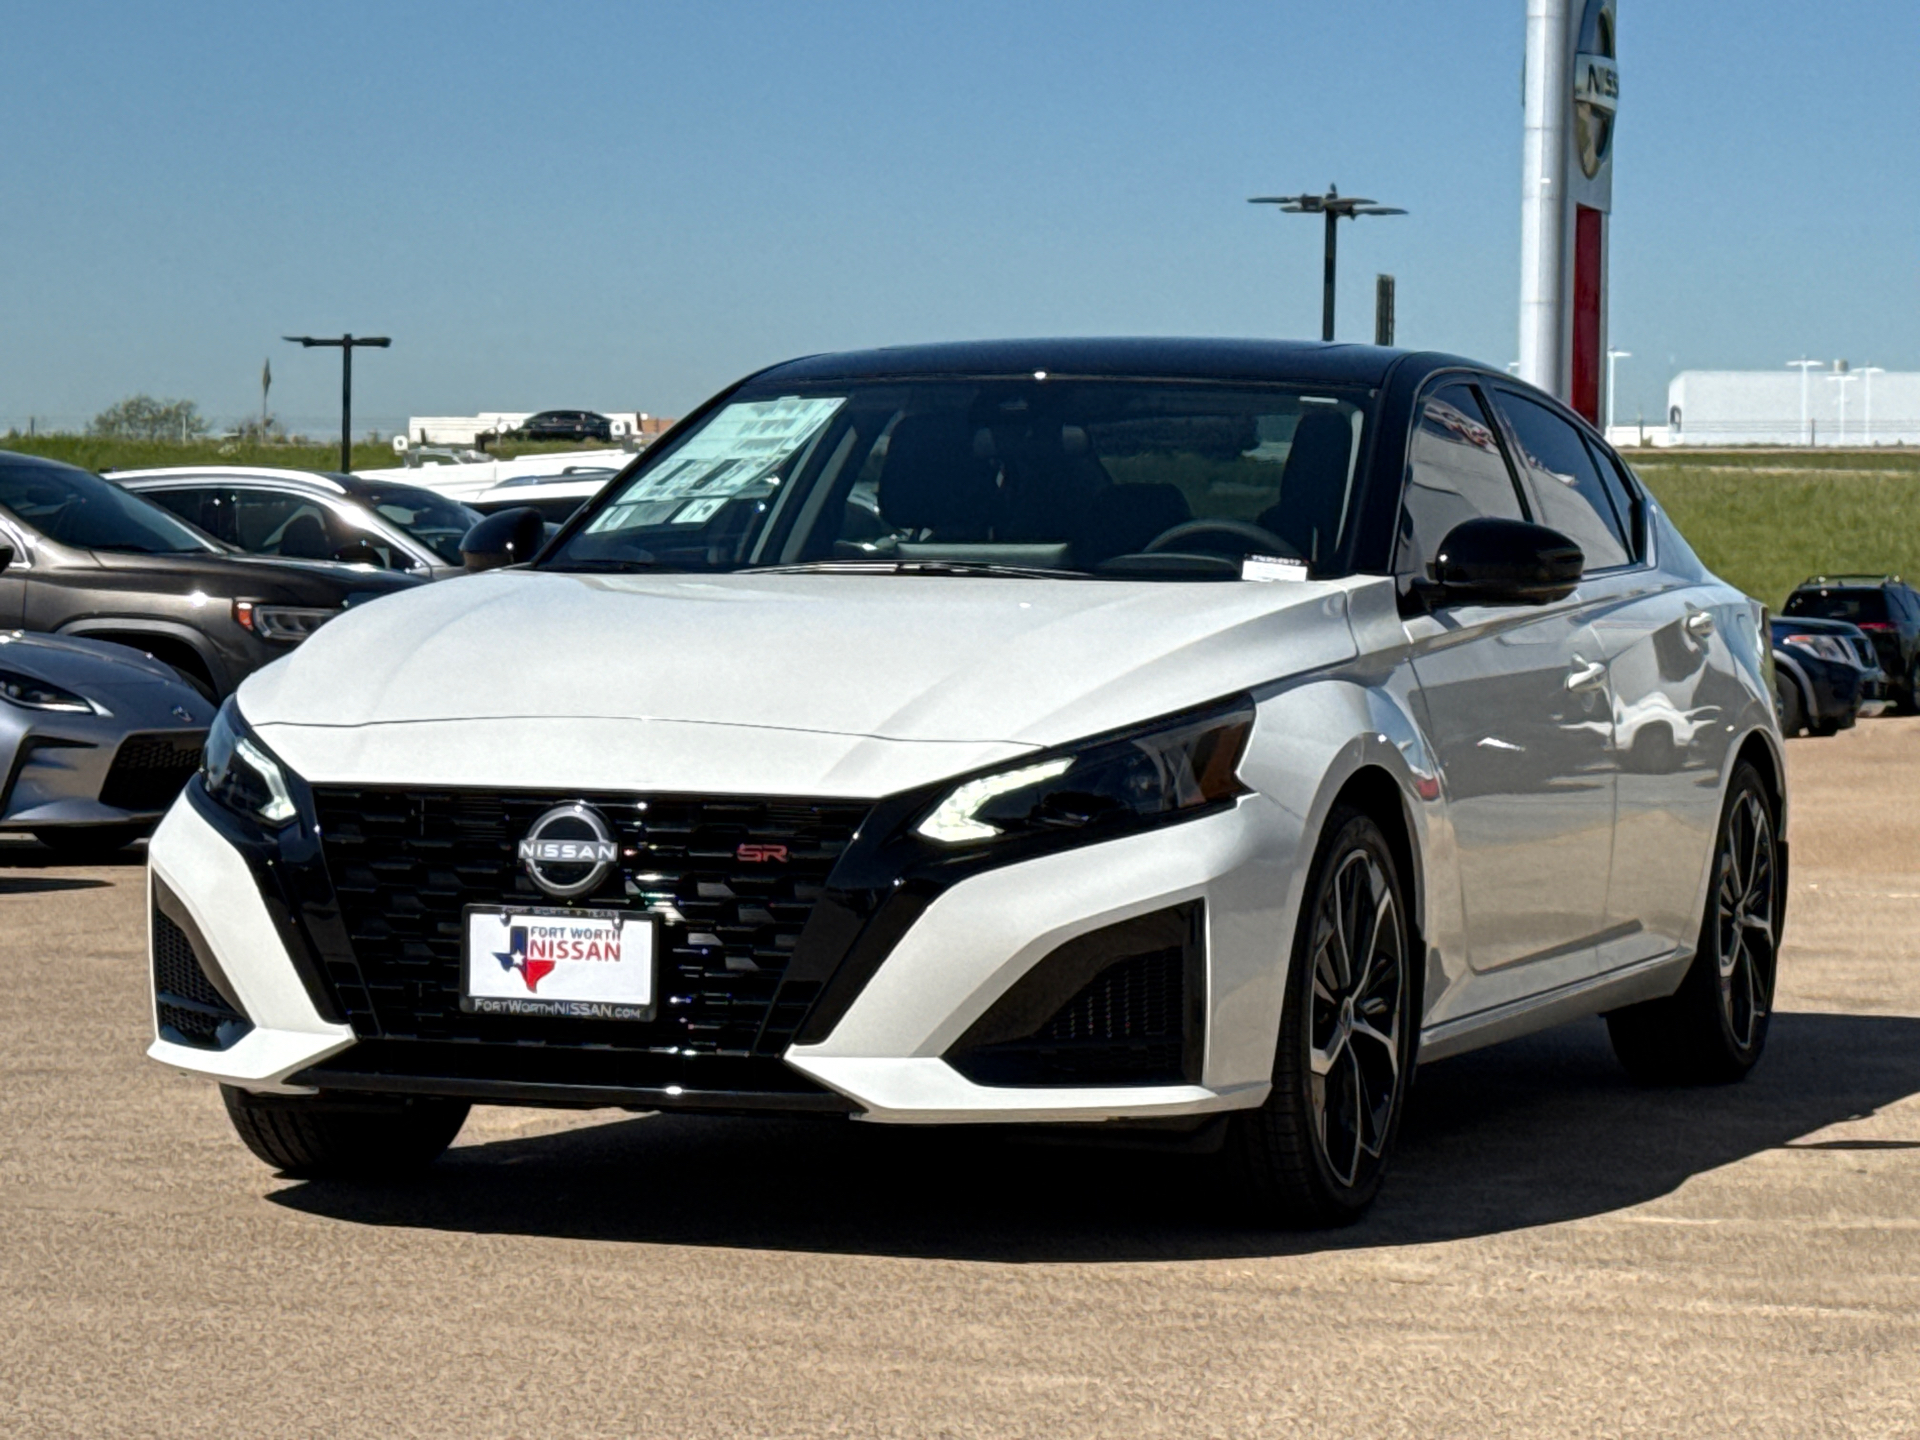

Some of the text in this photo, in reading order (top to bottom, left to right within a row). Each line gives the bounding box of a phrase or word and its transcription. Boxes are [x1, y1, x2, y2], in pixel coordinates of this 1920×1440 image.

[520, 842, 615, 859] NISSAN
[737, 843, 788, 863] SR
[530, 926, 621, 941] FORT WORTH
[529, 939, 621, 962] NISSAN
